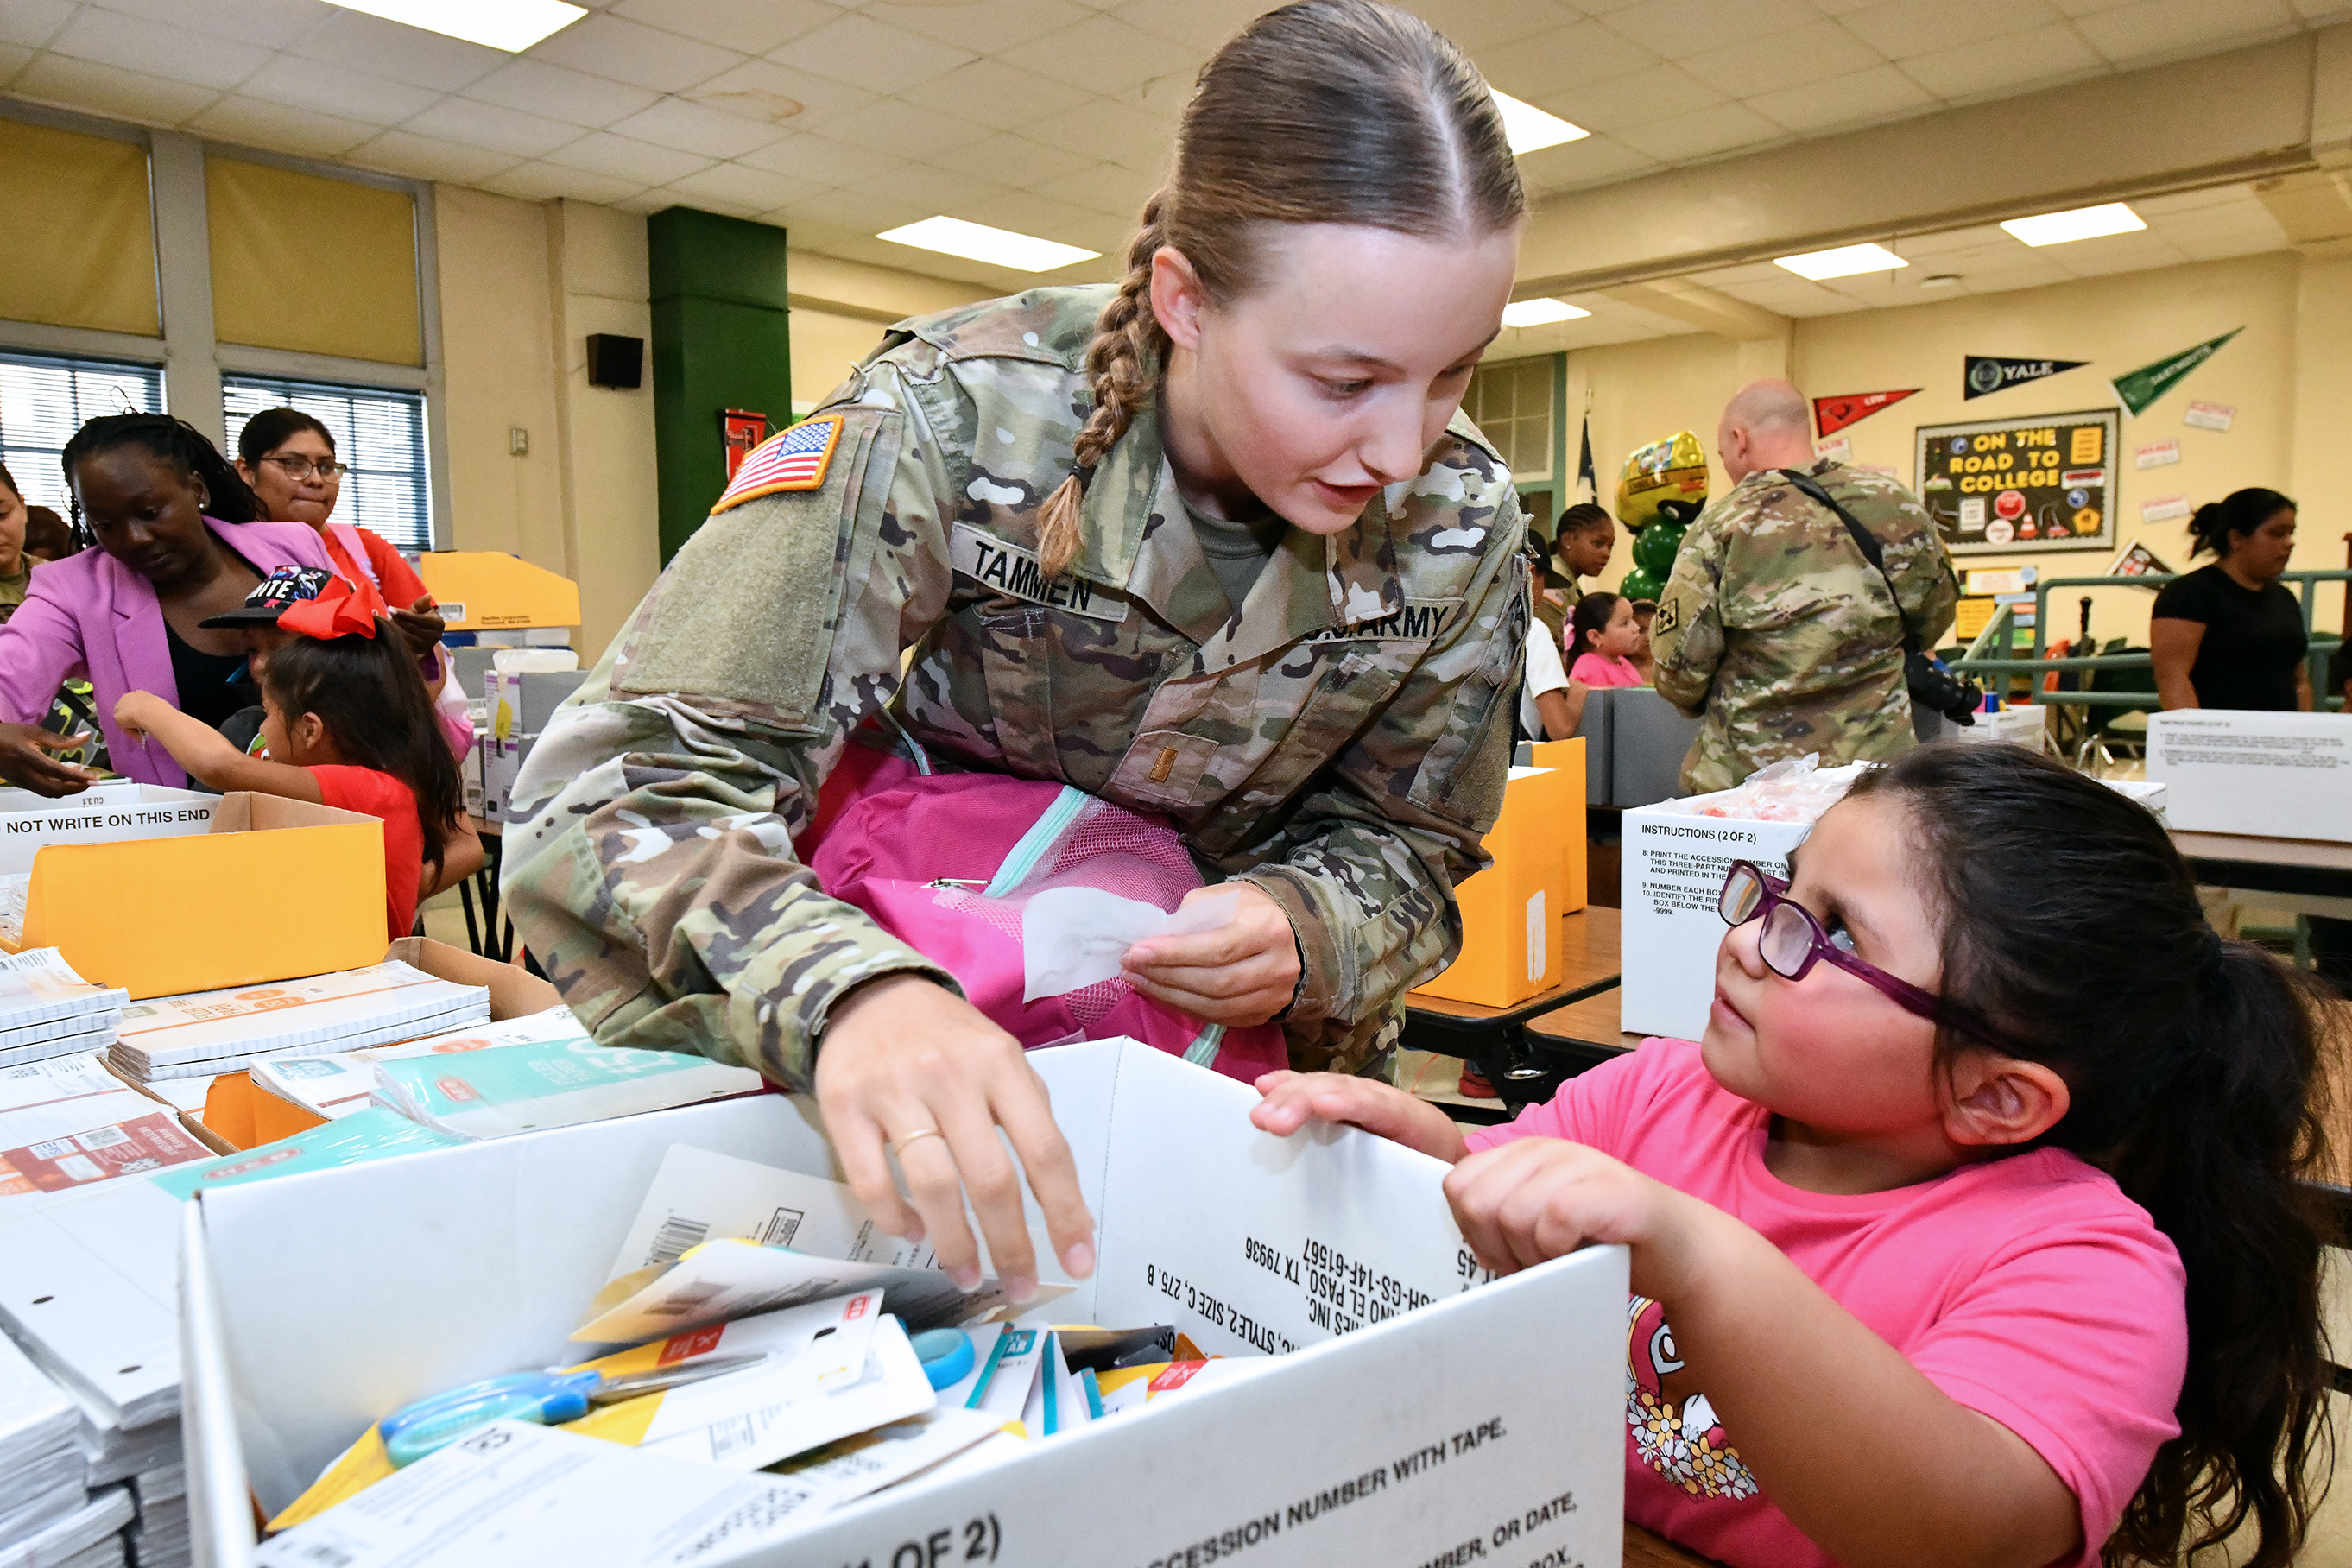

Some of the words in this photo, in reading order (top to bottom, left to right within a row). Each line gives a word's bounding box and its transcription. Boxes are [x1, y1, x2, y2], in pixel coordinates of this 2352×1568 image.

[2004, 361, 2054, 380] YALE
[1973, 433, 2007, 452] ON
[2015, 428, 2056, 448] THE
[1949, 453, 2014, 473] ROAD
[2028, 450, 2060, 468] TO
[1960, 469, 2060, 493] COLLEGE
[7, 819, 43, 834] NOT
[48, 816, 103, 831] WRITE
[108, 813, 132, 826] ON
[136, 811, 173, 825] THIS
[178, 808, 210, 821] END
[1641, 825, 1715, 840] INSTRUCTIONS
[1717, 831, 1728, 843] (2
[1729, 831, 1744, 842] OF
[1747, 833, 1757, 845] 2)
[1668, 860, 1716, 871] THREE-PART
[1690, 854, 1735, 864] ACCESSION
[1667, 869, 1700, 878] PRINTED
[1650, 882, 1681, 892] NUMBER
[1684, 886, 1704, 895] EACH
[1653, 891, 1686, 901] IDENTIFY
[1672, 901, 1698, 910] BELOW
[1245, 1236, 1280, 1275] 79936
[1457, 1249, 1477, 1279] 45
[1148, 1264, 1154, 1286] B
[1285, 1255, 1299, 1285] TX
[1185, 1280, 1196, 1309] C,
[1306, 1261, 1344, 1307] PASO,
[1198, 1292, 1224, 1326] SIZE
[1306, 1295, 1331, 1331] INC.
[1350, 1288, 1365, 1318] EL
[1148, 1509, 1280, 1568] CESSION
[1287, 1466, 1388, 1529] NUMBER
[1393, 1440, 1447, 1483] WITH
[1451, 1415, 1508, 1457] TAPE.
[1492, 1517, 1521, 1548] OR
[1525, 1489, 1578, 1533] DATE,
[892, 1527, 952, 1568] OF
[964, 1510, 1002, 1565] 2)
